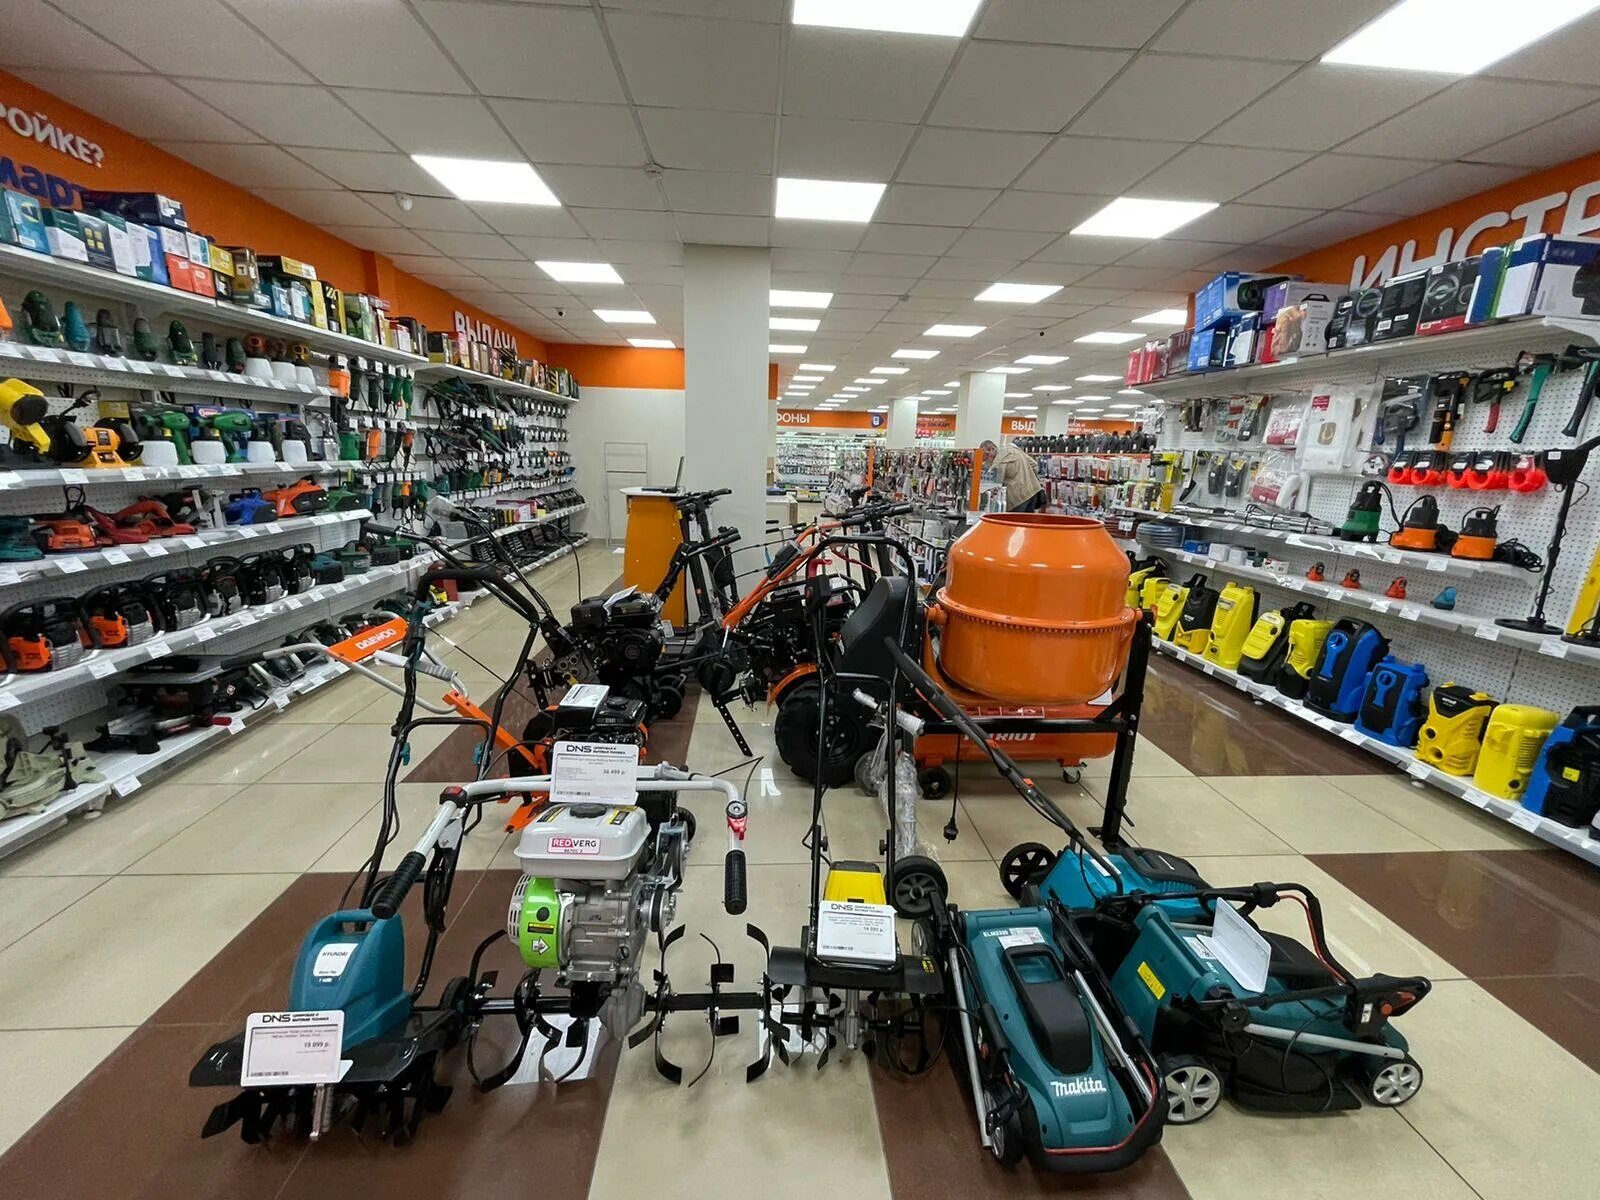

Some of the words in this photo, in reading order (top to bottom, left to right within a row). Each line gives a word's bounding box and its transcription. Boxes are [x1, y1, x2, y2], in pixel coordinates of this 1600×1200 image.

[355, 628, 396, 650] DAEWOO
[566, 744, 592, 753] DNS
[553, 838, 597, 848] REDVERG
[831, 903, 854, 912] DNS
[262, 1014, 291, 1023] DNS
[1050, 1080, 1106, 1097] Makita
